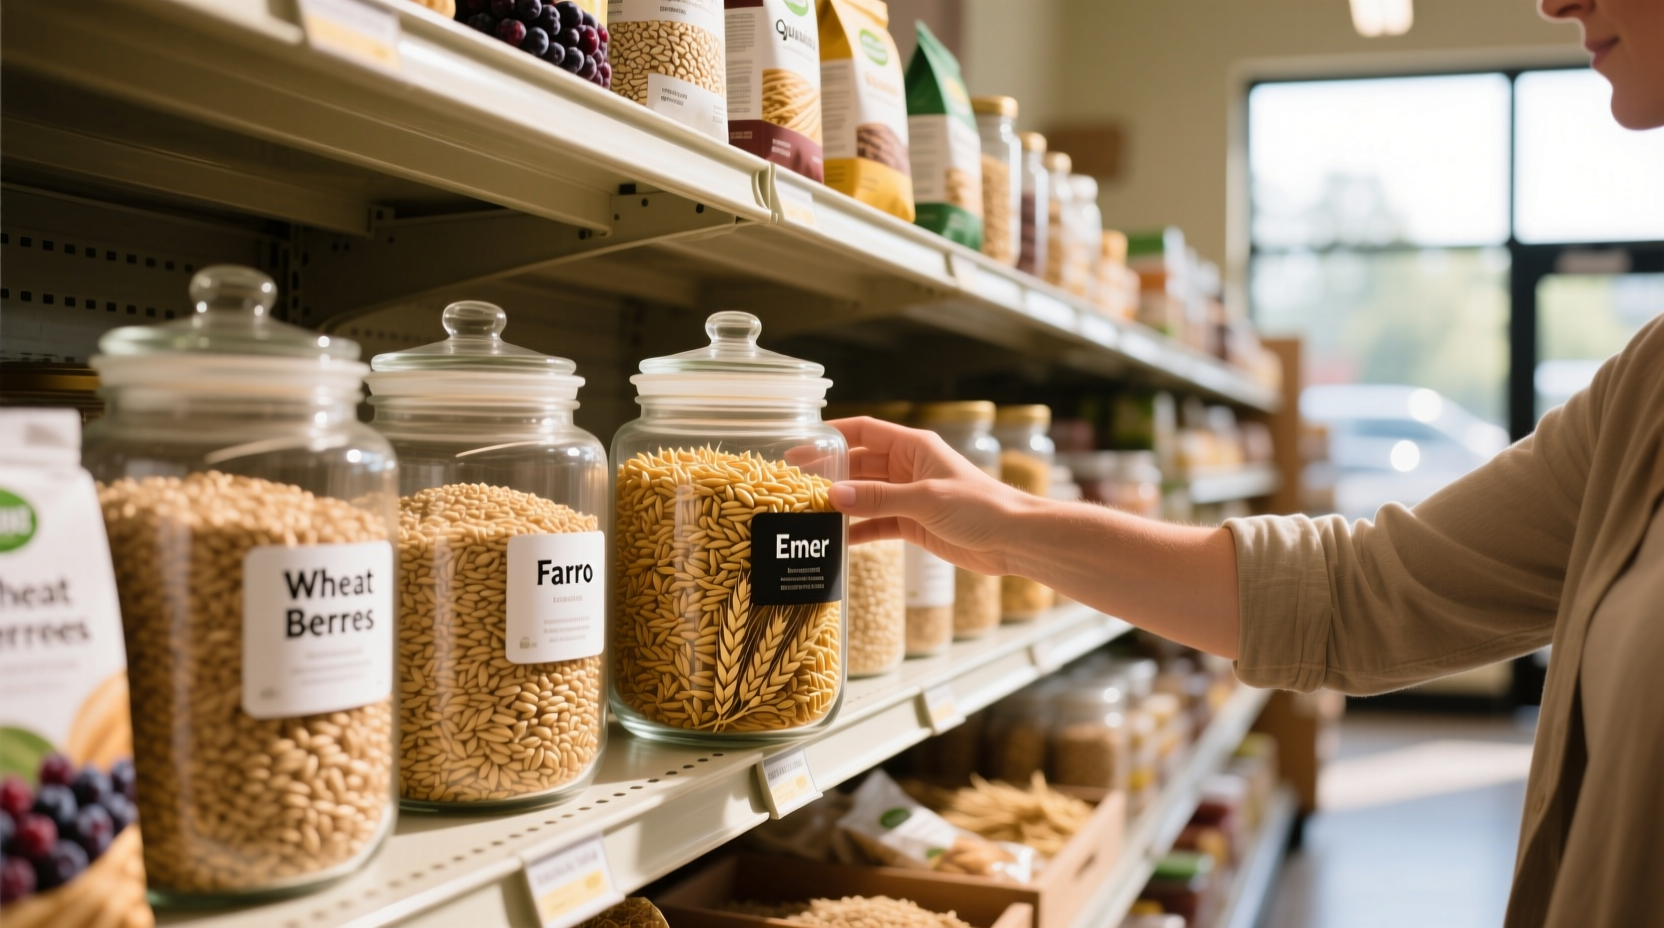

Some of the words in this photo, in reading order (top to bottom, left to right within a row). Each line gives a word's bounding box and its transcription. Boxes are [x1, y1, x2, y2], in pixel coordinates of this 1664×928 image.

[776, 534, 829, 559] Emer
[284, 568, 374, 600] Wheat
[537, 559, 593, 585] Farro
[0, 577, 71, 607] heat
[286, 608, 374, 639] Berres
